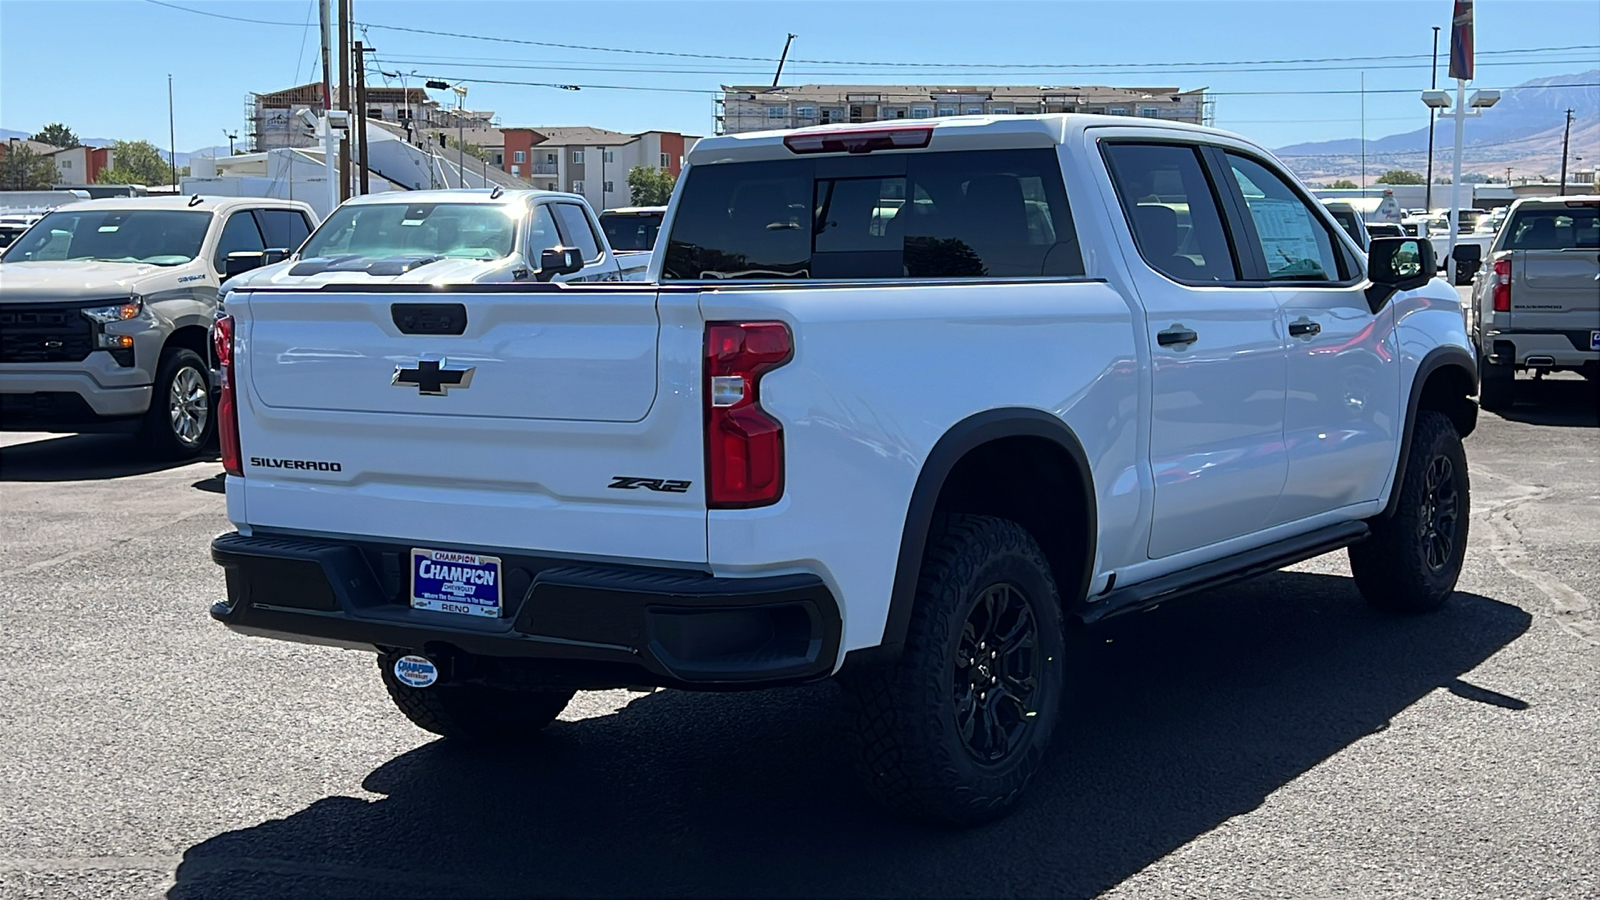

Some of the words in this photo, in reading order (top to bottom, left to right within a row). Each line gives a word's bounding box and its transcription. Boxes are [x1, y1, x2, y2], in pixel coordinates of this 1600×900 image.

[250, 456, 342, 472] SILVERADO
[607, 476, 693, 493] ZR2
[434, 552, 476, 563] CHAMPION
[419, 559, 496, 586] CHAMPION
[443, 583, 474, 593] CHEVROLET
[441, 603, 470, 613] RENO
